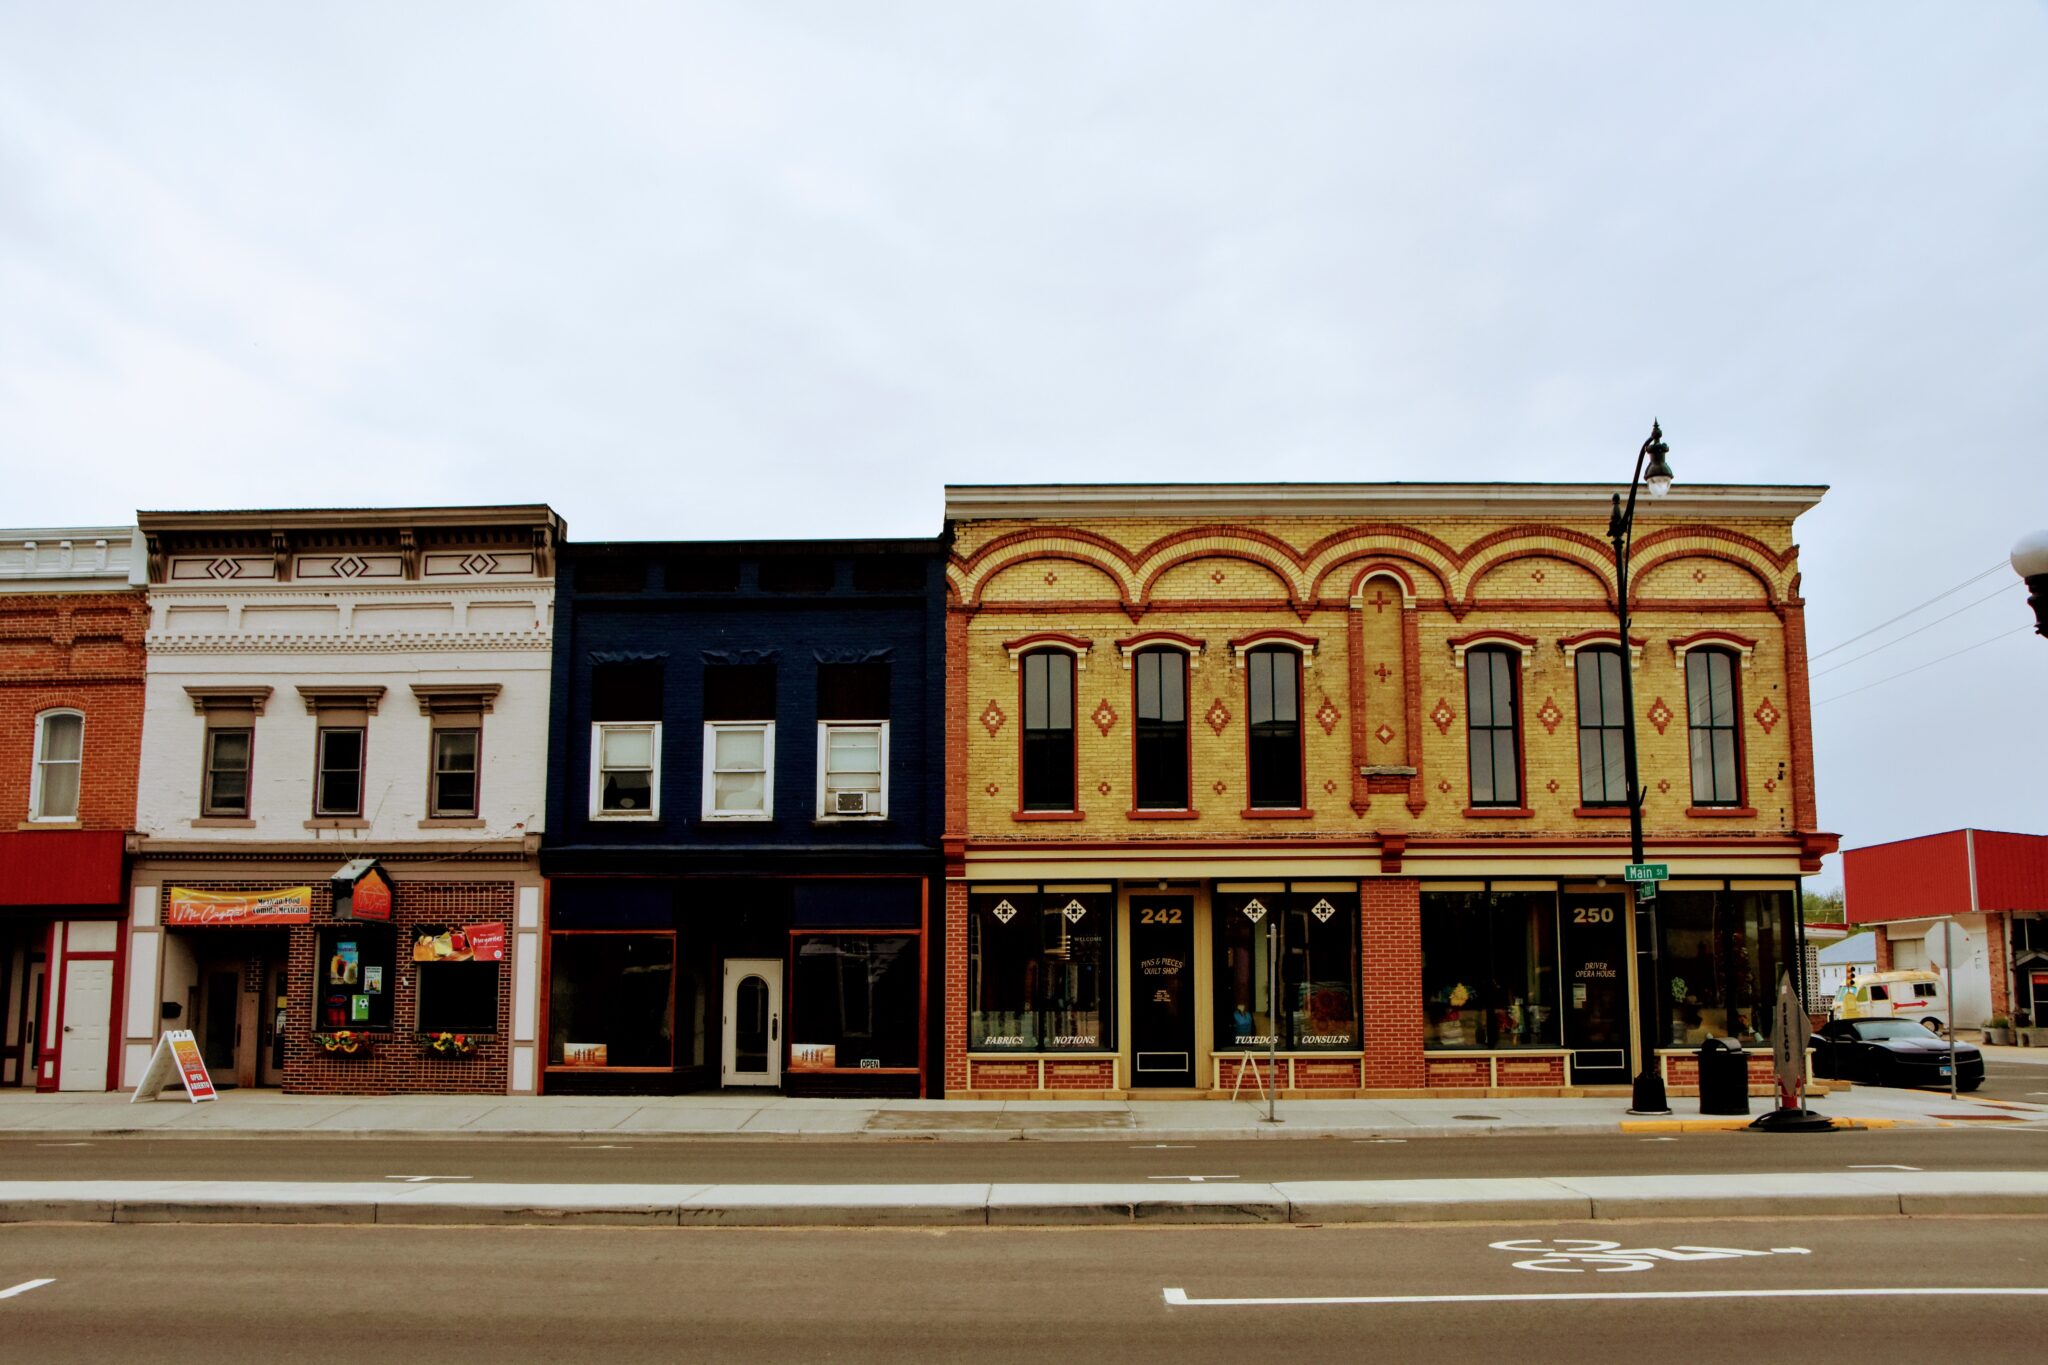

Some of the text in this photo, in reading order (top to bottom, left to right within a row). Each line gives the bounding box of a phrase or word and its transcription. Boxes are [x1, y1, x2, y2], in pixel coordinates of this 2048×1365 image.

[1630, 866, 1653, 879] Main
[252, 905, 308, 914] Comida Mexicana
[1141, 908, 1182, 924] 242
[1573, 908, 1614, 923] 250
[1141, 959, 1155, 969] PINS
[1161, 957, 1183, 969] PIECES
[1585, 962, 1607, 970] DRIVER
[1144, 967, 1179, 975] QUILT SHOP
[1575, 970, 1616, 978] OPERA HOUSE
[984, 1036, 1025, 1045] FABRICS
[1053, 1035, 1096, 1045] NOTIONS
[1301, 1035, 1349, 1044] CONSULTS
[861, 1060, 879, 1068] OPEN
